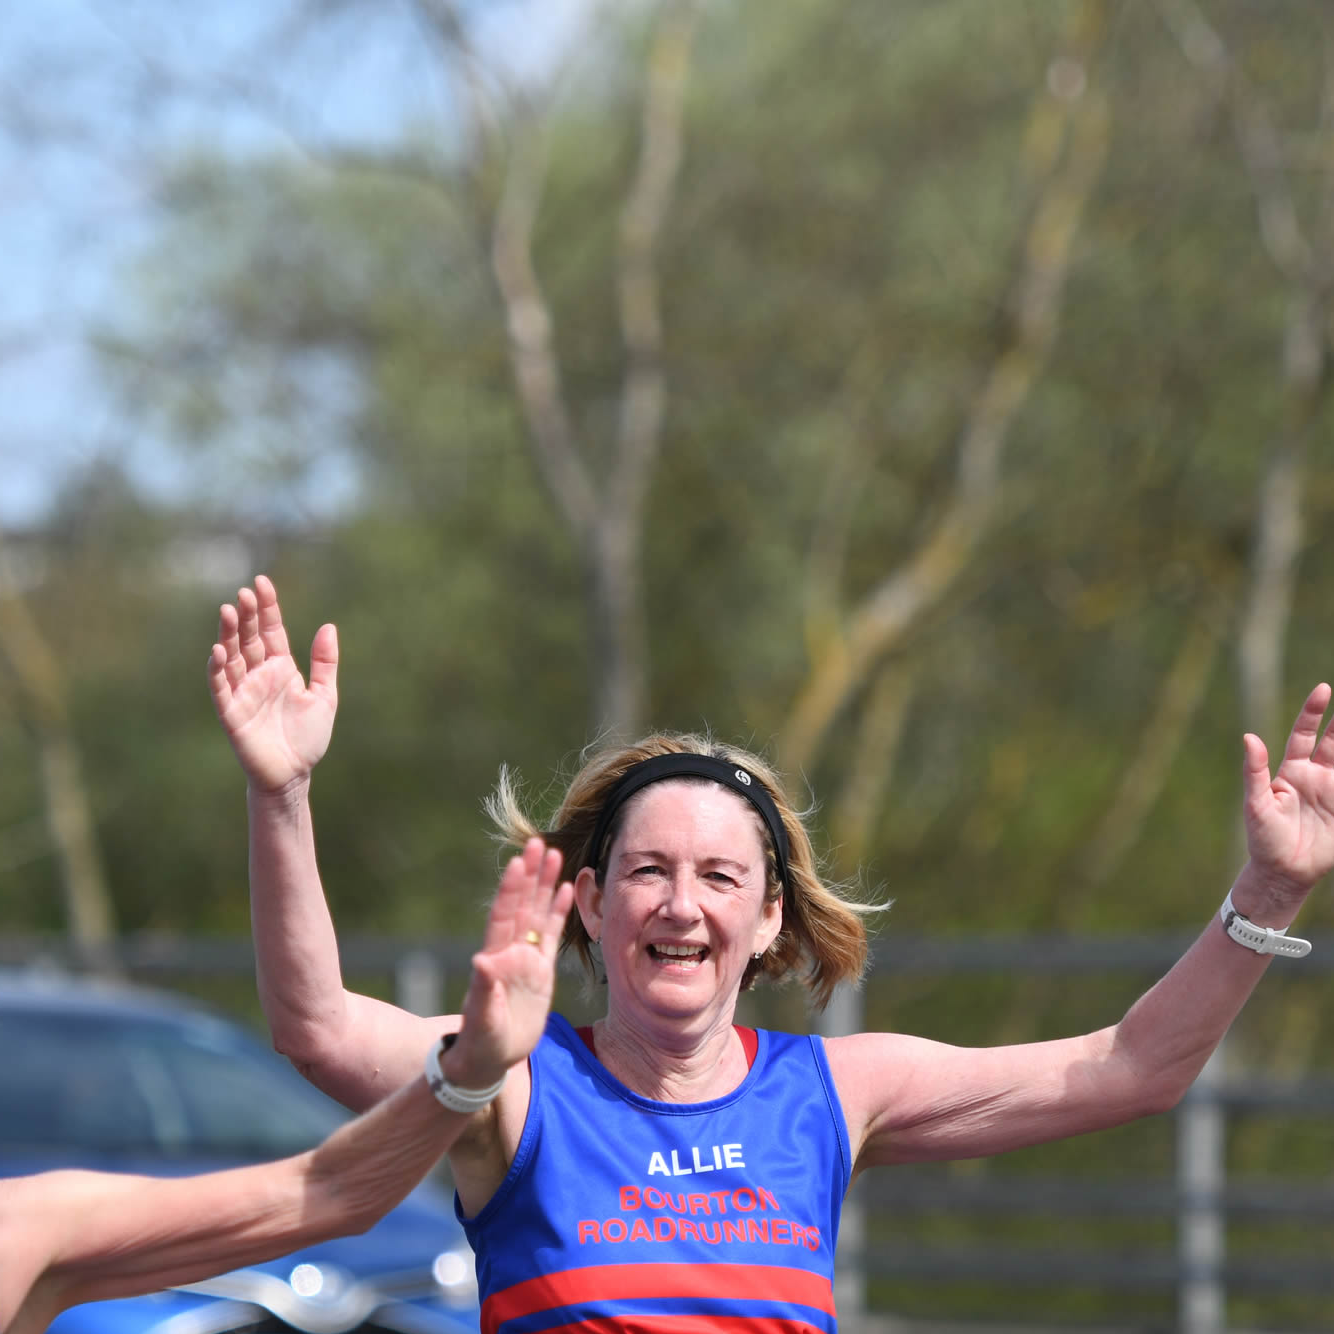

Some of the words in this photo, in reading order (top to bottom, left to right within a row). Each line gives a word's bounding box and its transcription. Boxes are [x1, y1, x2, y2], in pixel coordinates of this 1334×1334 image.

[647, 1143, 745, 1176] ALLIE
[619, 1185, 780, 1216] BOURTON
[578, 1218, 820, 1252] ROADRUNNERS
